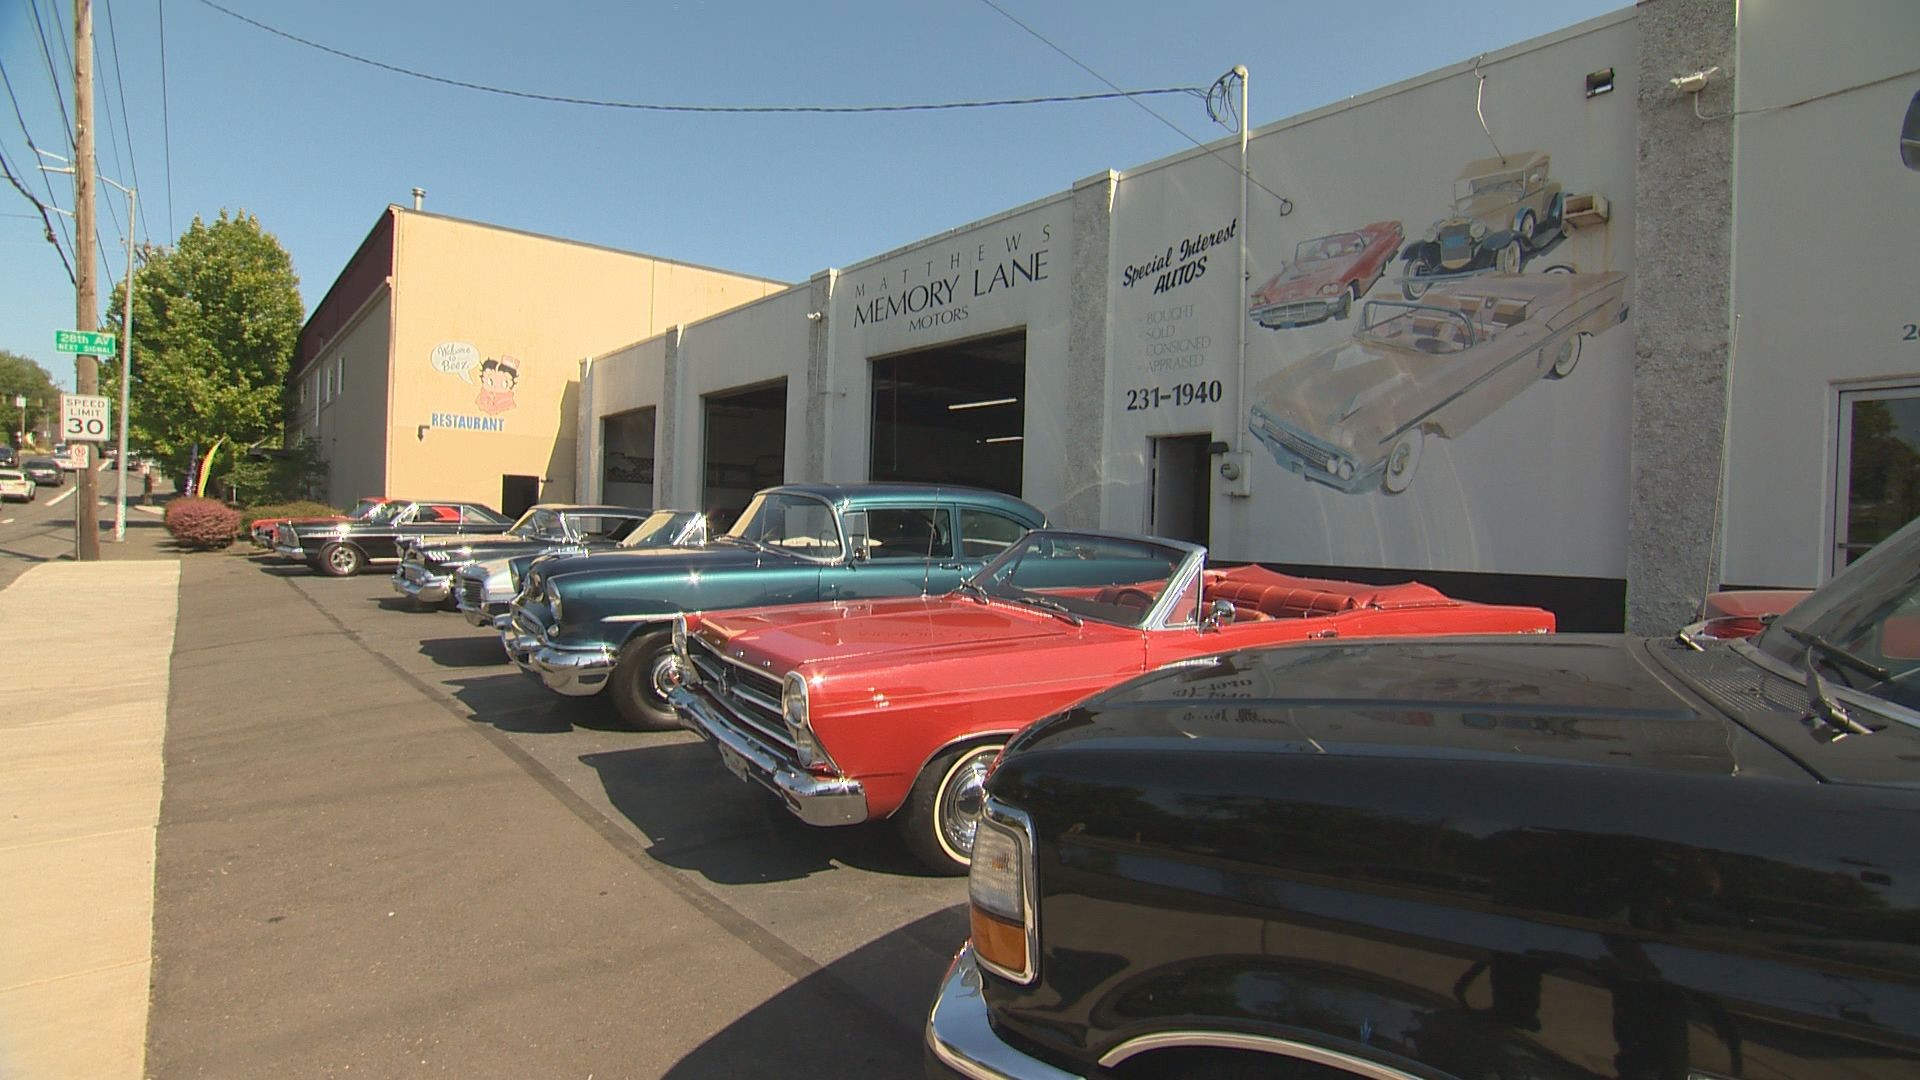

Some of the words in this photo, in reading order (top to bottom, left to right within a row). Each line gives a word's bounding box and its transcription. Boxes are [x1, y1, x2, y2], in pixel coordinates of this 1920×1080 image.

[856, 224, 1050, 298] MATTHEWS
[1123, 247, 1173, 287] Special
[1180, 218, 1237, 262] Interest
[1154, 256, 1208, 295] AUTOS
[853, 275, 960, 329] MEMORY
[974, 249, 1049, 297] LANE
[908, 305, 969, 332] MOTORS
[1146, 304, 1195, 325] BOUGHT
[94, 337, 110, 345] AV
[1903, 324, 1920, 341] 2
[58, 343, 79, 351] NEXT
[84, 345, 111, 353] SIGNAL
[66, 399, 106, 408] SPEED
[1127, 380, 1223, 411] 231-1940
[70, 408, 101, 417] LIMIT
[431, 412, 505, 431] RESTAURANT
[68, 418, 105, 435] 30
